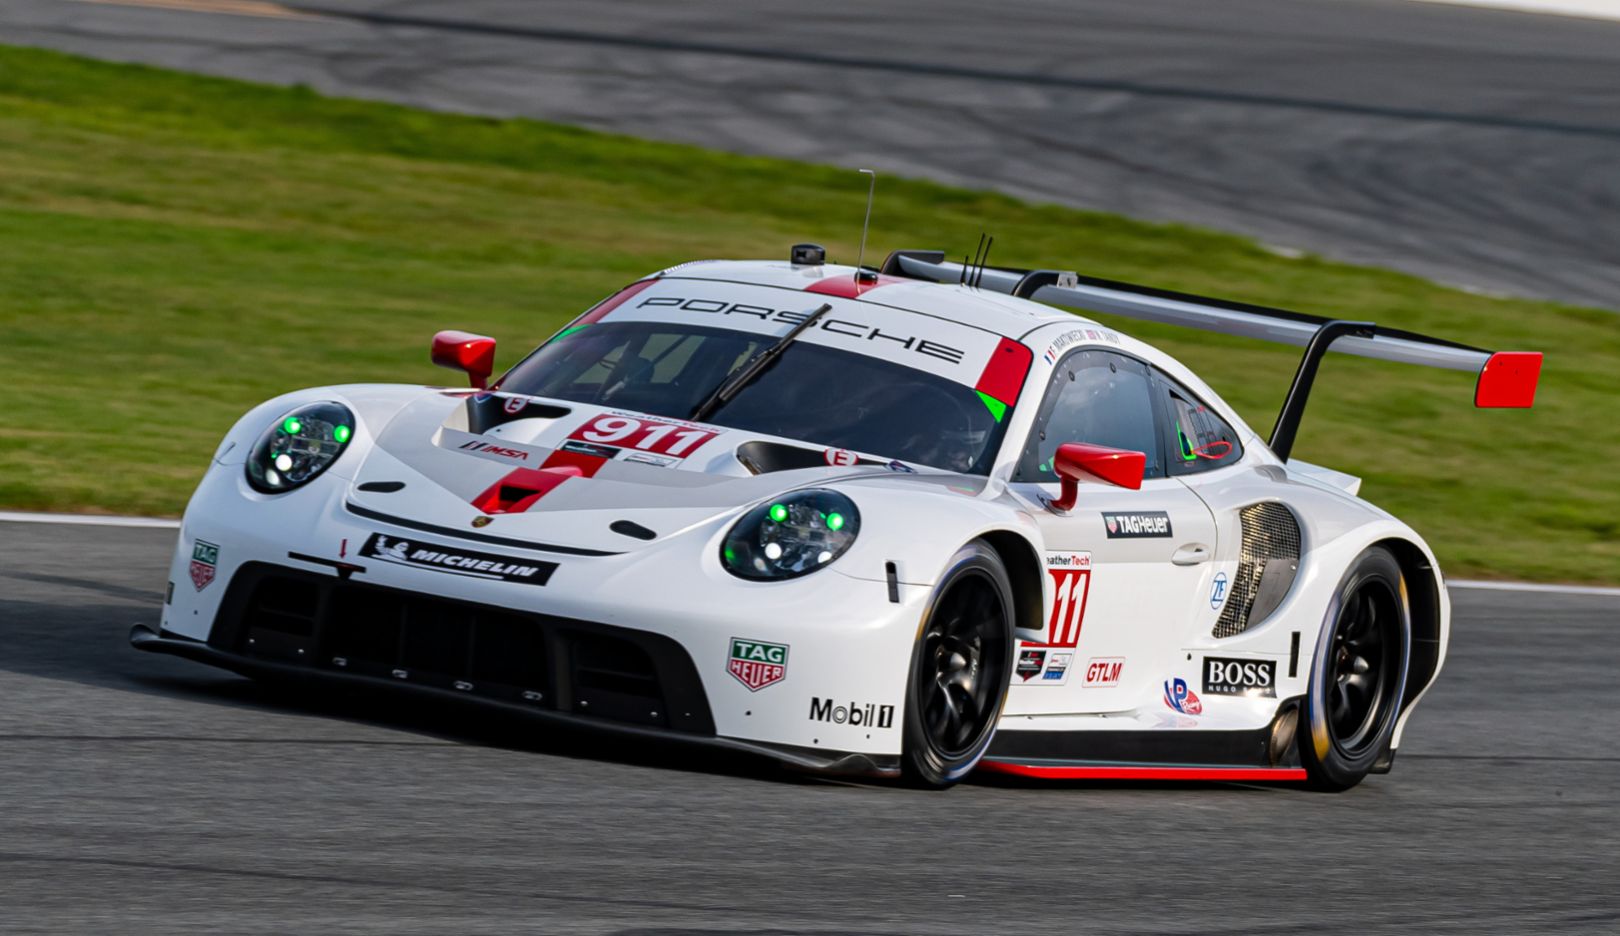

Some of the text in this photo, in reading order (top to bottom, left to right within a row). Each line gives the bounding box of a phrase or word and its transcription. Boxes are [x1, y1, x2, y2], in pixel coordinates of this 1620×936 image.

[636, 297, 965, 364] PORSCHE
[582, 417, 709, 455] 911
[480, 445, 529, 460] IMSA
[833, 451, 848, 466] E
[194, 543, 217, 564] TAG
[410, 549, 540, 577] MICHELIN
[1211, 580, 1227, 602] ZF
[735, 642, 784, 663] TAG
[731, 660, 782, 687] HEUER
[1086, 662, 1123, 682] GTLM
[1208, 661, 1271, 686] BOSS
[1208, 685, 1237, 693] HUGO
[809, 697, 895, 729] Mobil 1
